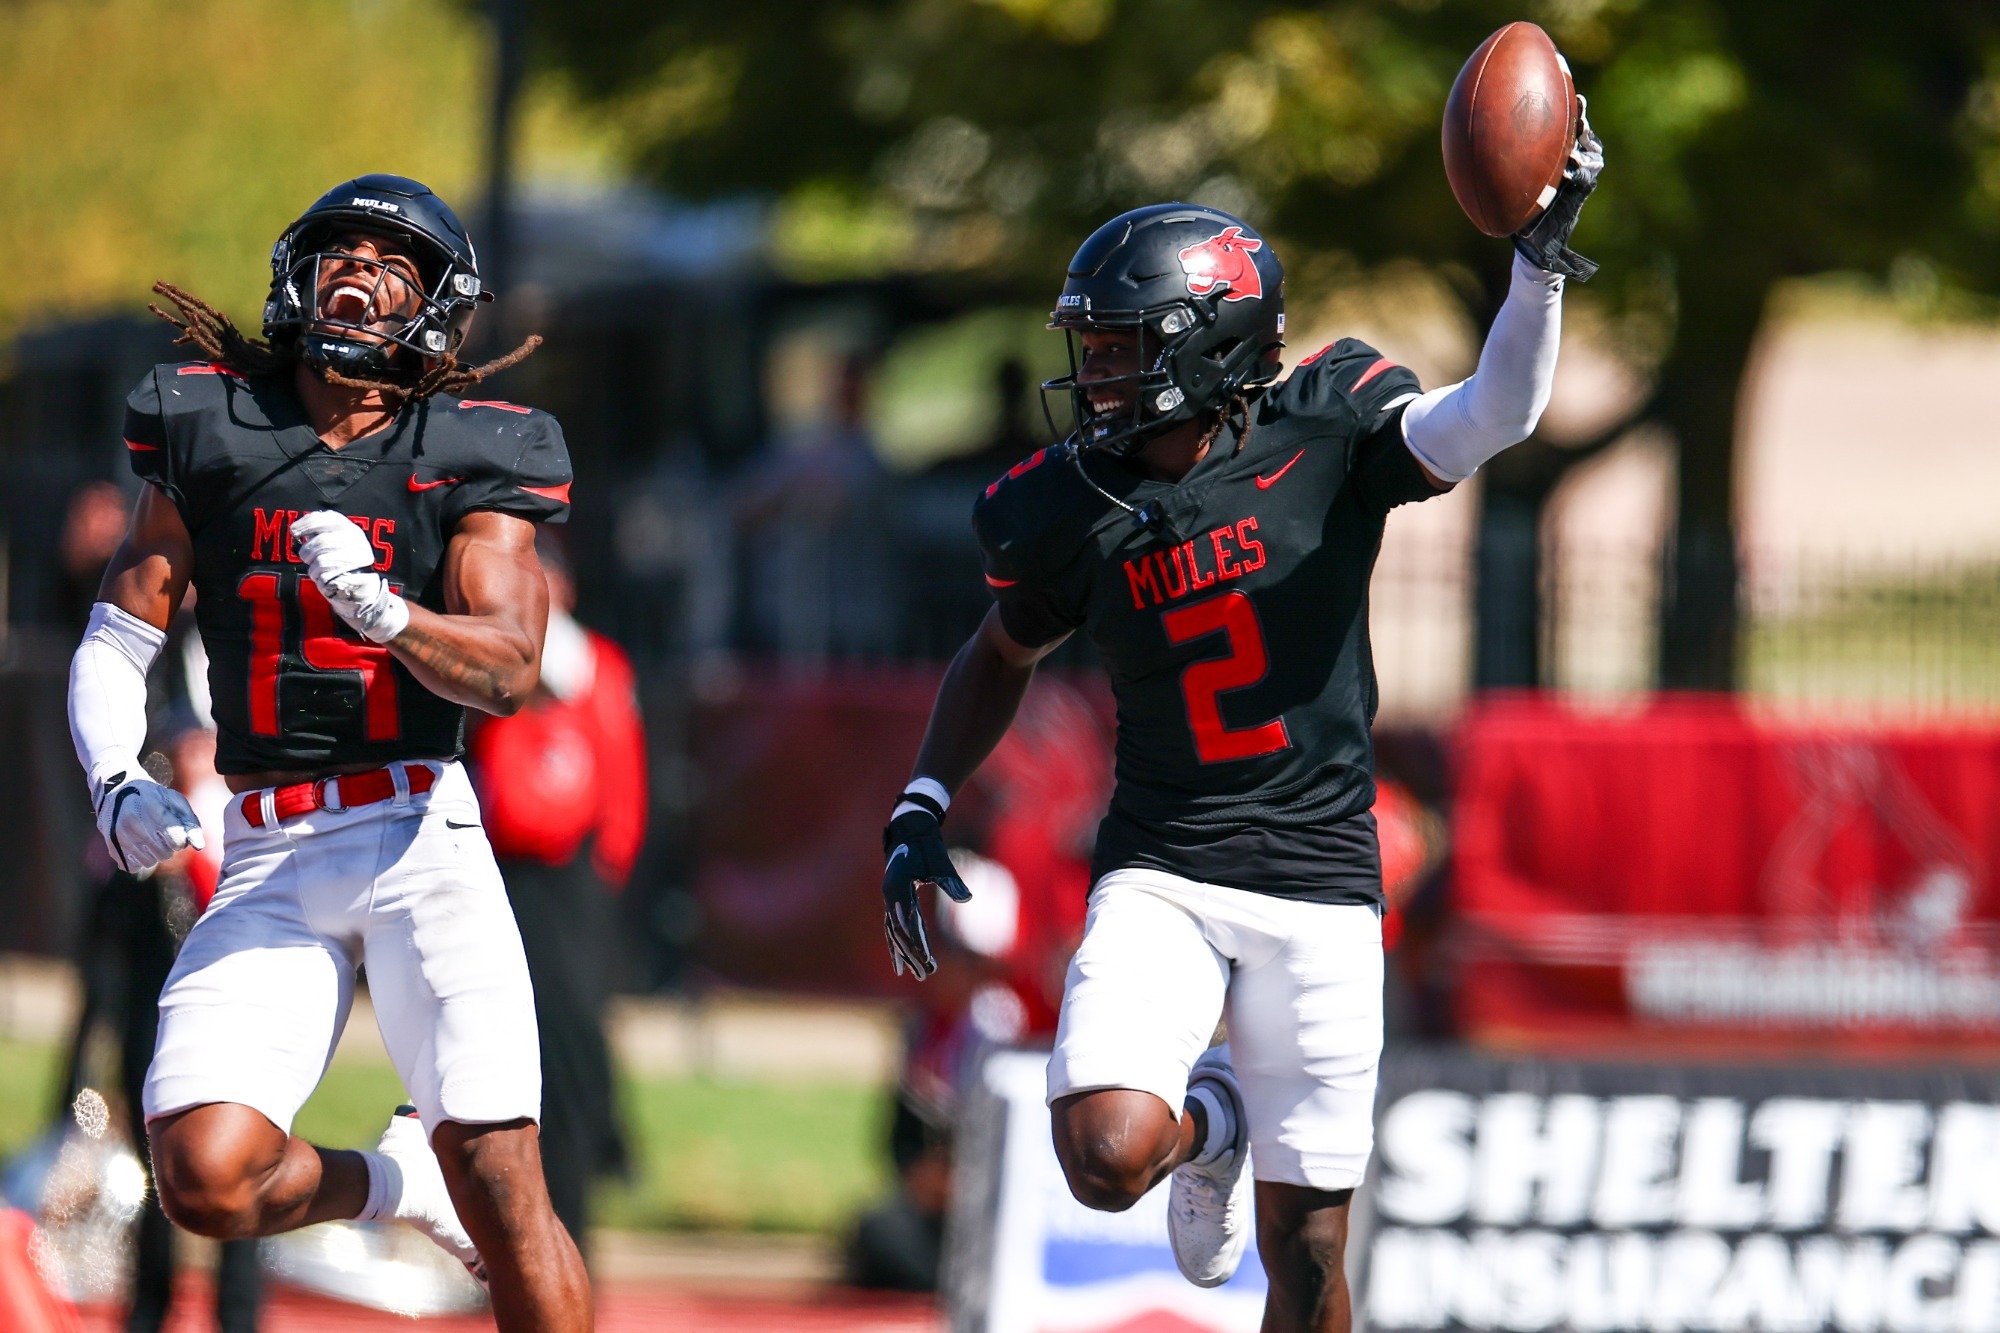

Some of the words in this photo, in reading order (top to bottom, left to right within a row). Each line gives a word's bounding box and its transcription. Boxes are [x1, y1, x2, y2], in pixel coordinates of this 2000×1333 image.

[352, 197, 399, 213] MULES
[1123, 516, 1267, 610] MULES
[1160, 588, 1293, 765] 2
